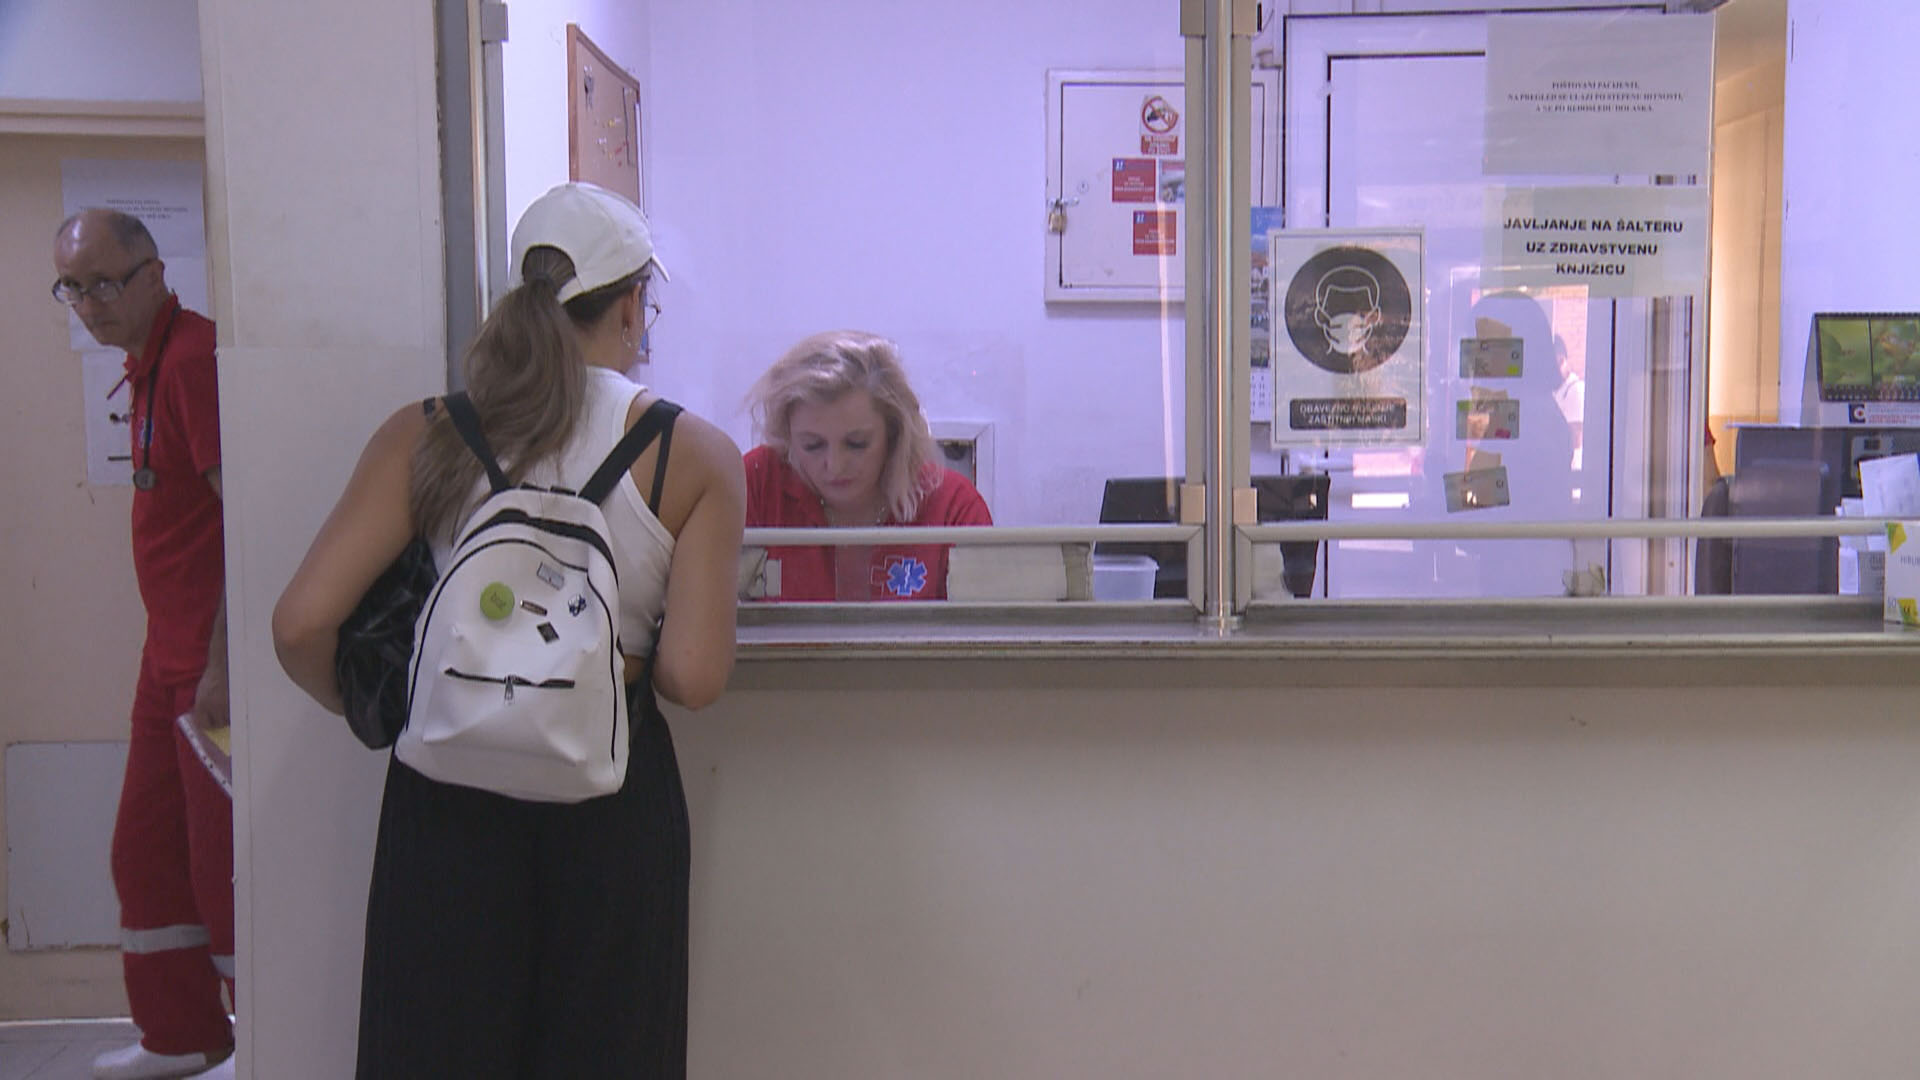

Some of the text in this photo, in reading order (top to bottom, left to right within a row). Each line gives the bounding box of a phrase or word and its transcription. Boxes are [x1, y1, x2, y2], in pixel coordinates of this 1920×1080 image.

[1504, 217, 1684, 233] JAVLJANJE NA ŠALTERU
[1526, 241, 1658, 255] UZ ZDRAVSTVENU
